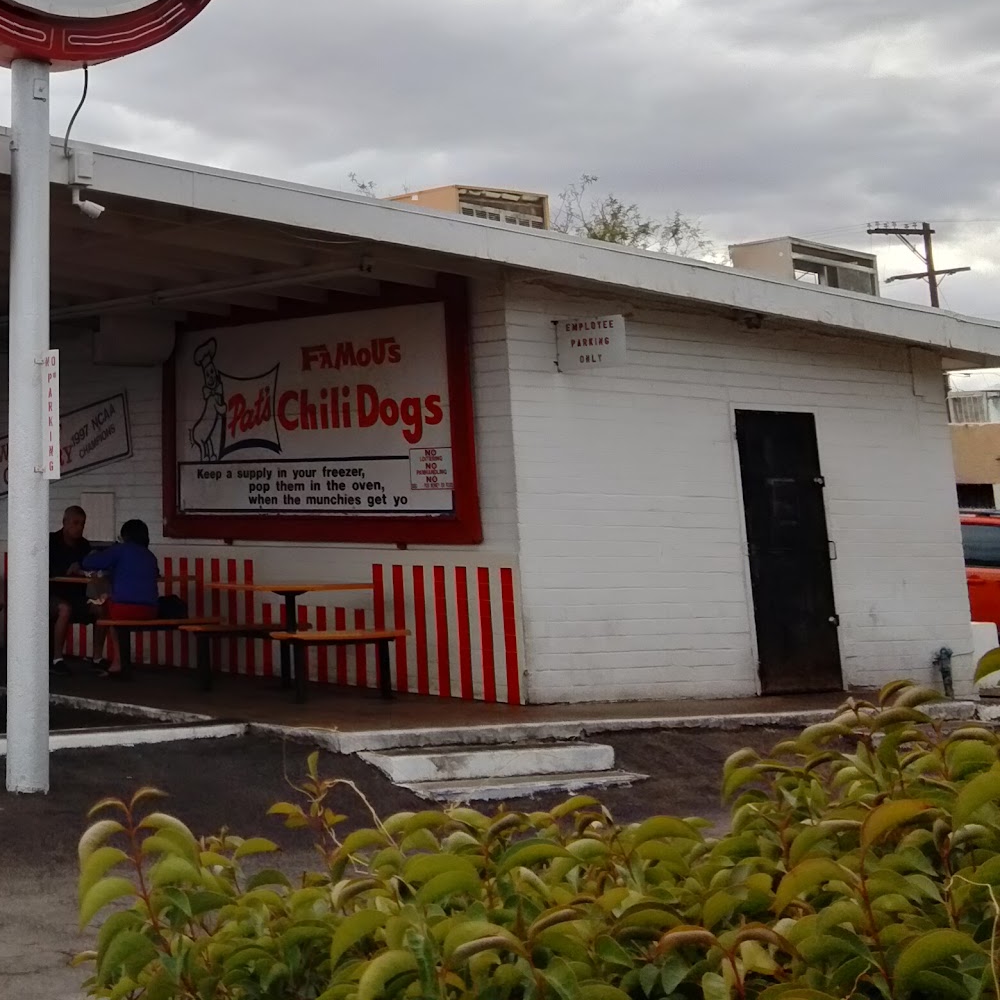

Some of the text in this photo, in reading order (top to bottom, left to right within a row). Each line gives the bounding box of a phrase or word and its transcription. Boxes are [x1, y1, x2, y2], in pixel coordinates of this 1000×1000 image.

[565, 320, 614, 331] EMPLOYEE
[570, 337, 610, 347] PARKING
[45, 356, 56, 366] NO
[579, 354, 602, 363] ONLY
[228, 385, 271, 438] Pat's
[278, 384, 444, 444] Chili Dogs
[71, 403, 116, 446] 1997 NCAA
[79, 423, 116, 459] CHAMPIONS
[197, 466, 365, 480] Keep a supply in your freezer,
[249, 480, 385, 493] pop them in the oven,
[248, 494, 408, 507] when the munchies get yo
